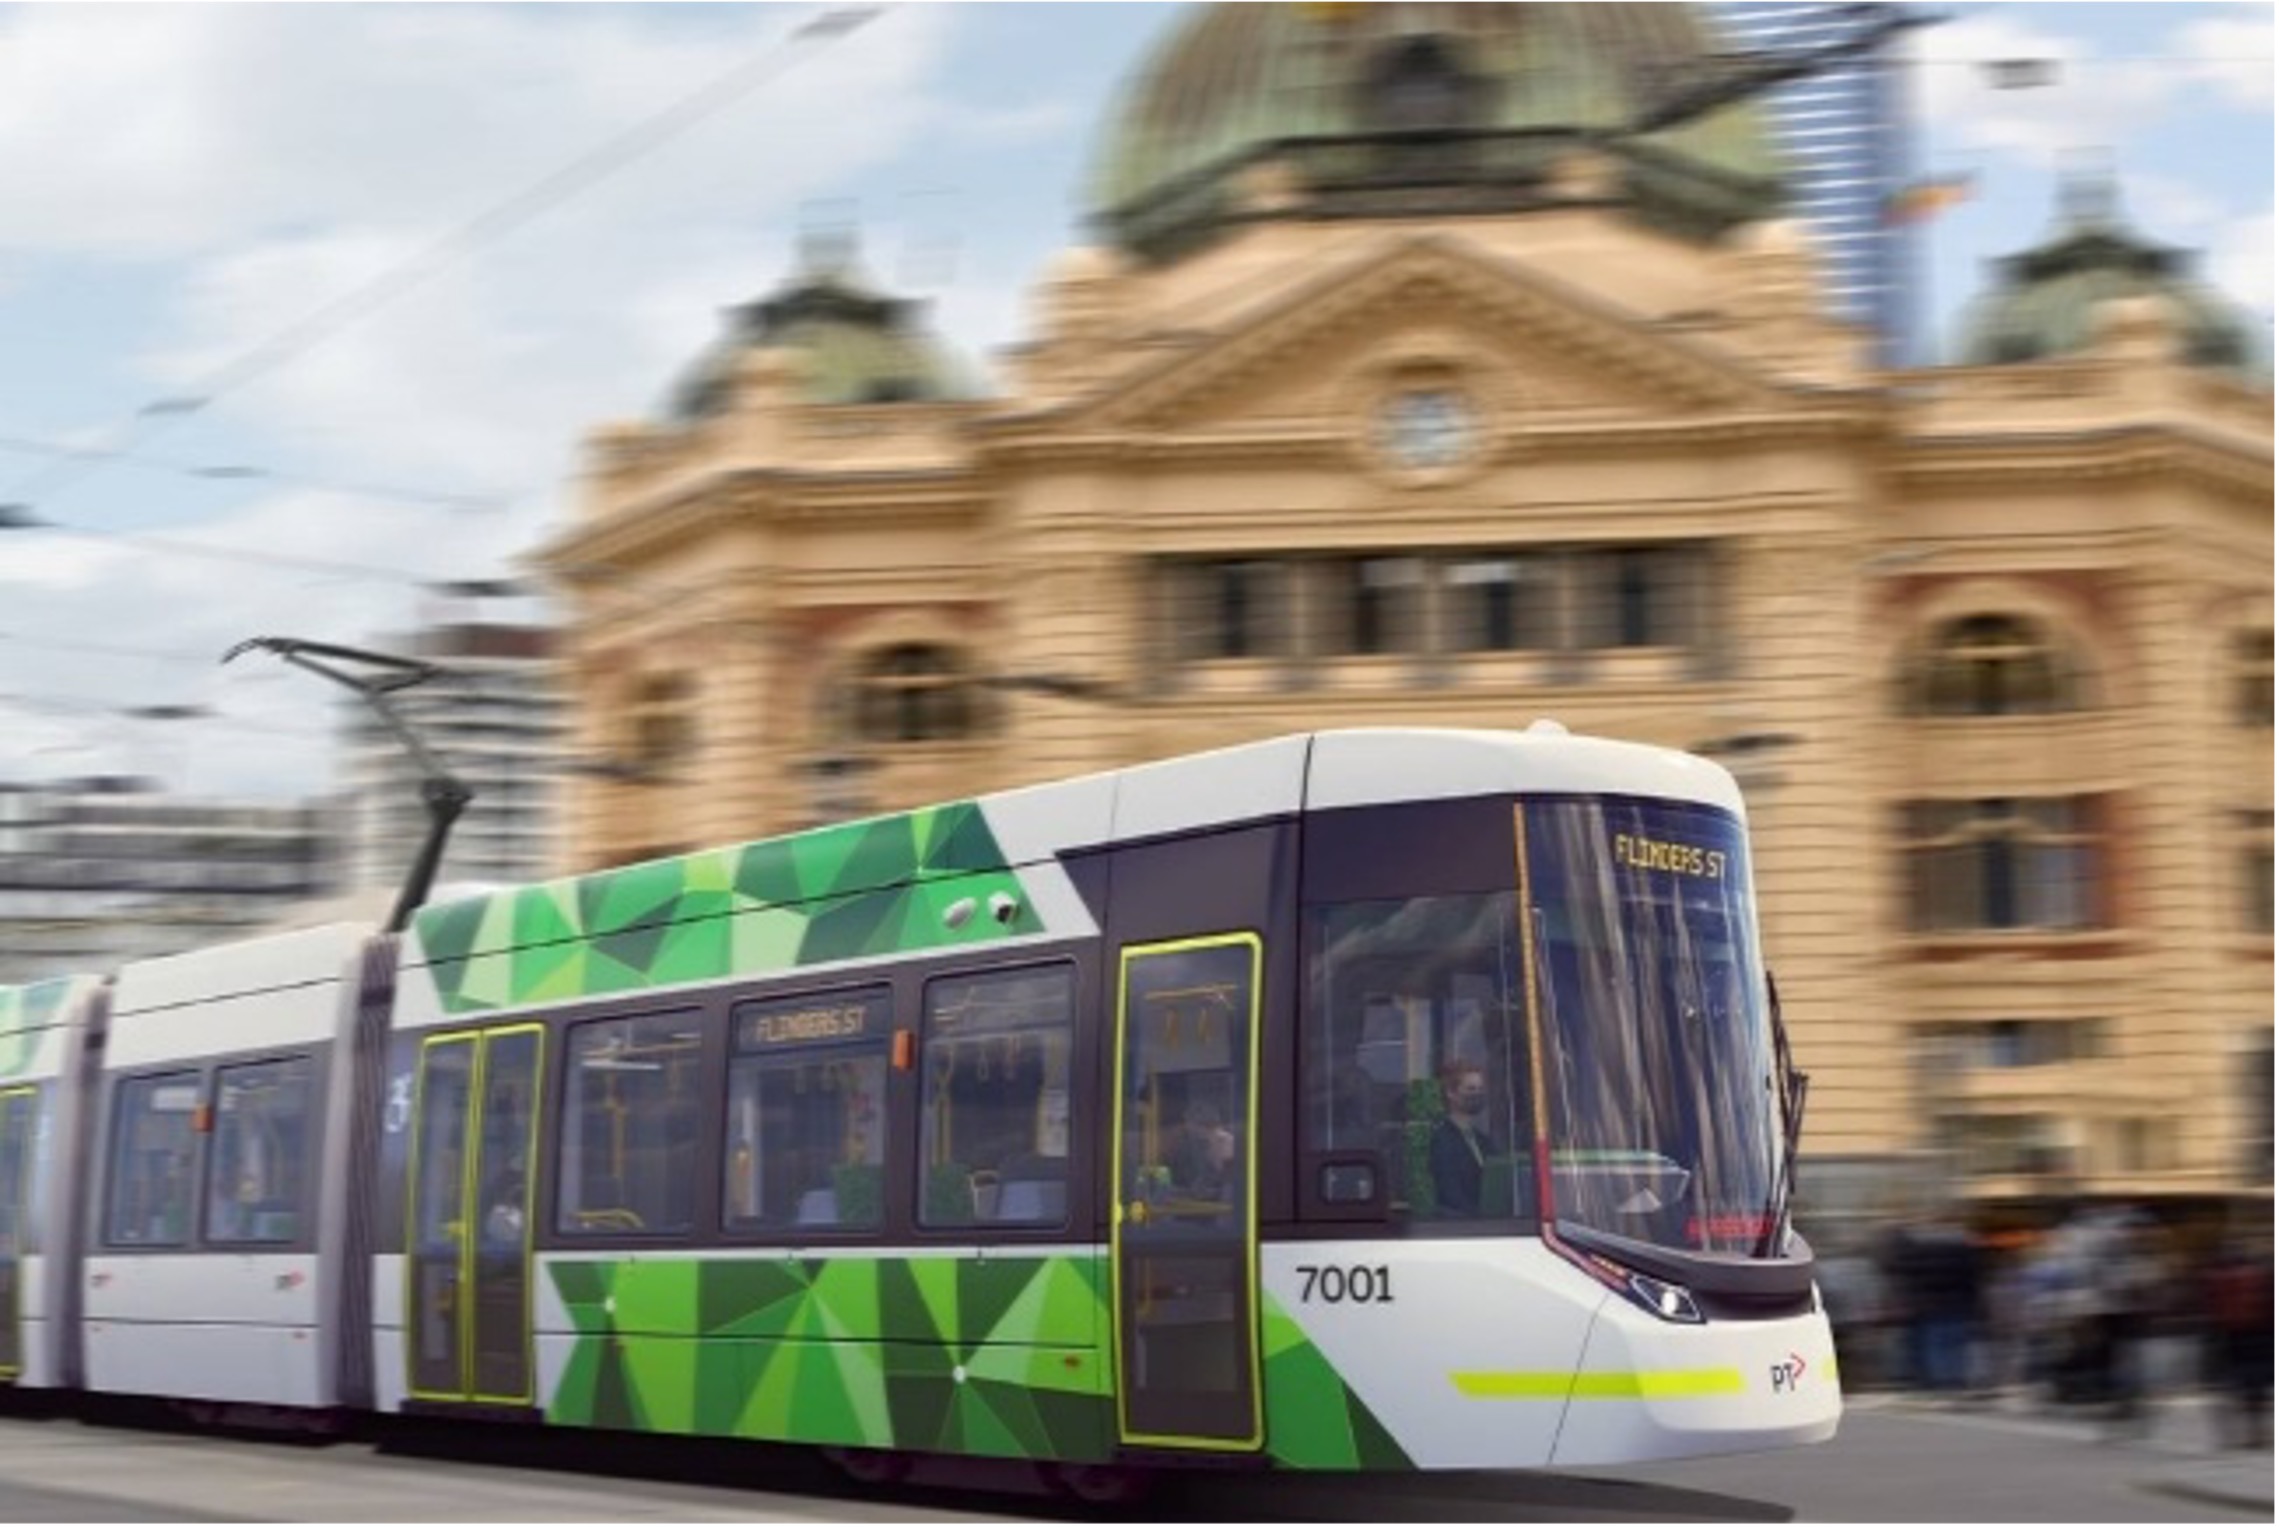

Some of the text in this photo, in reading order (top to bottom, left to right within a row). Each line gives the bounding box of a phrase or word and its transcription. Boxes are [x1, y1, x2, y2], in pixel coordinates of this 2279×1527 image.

[1615, 833, 1726, 878] FLINDERS ST
[844, 1005, 867, 1034] ST
[1296, 1265, 1393, 1303] 7001
